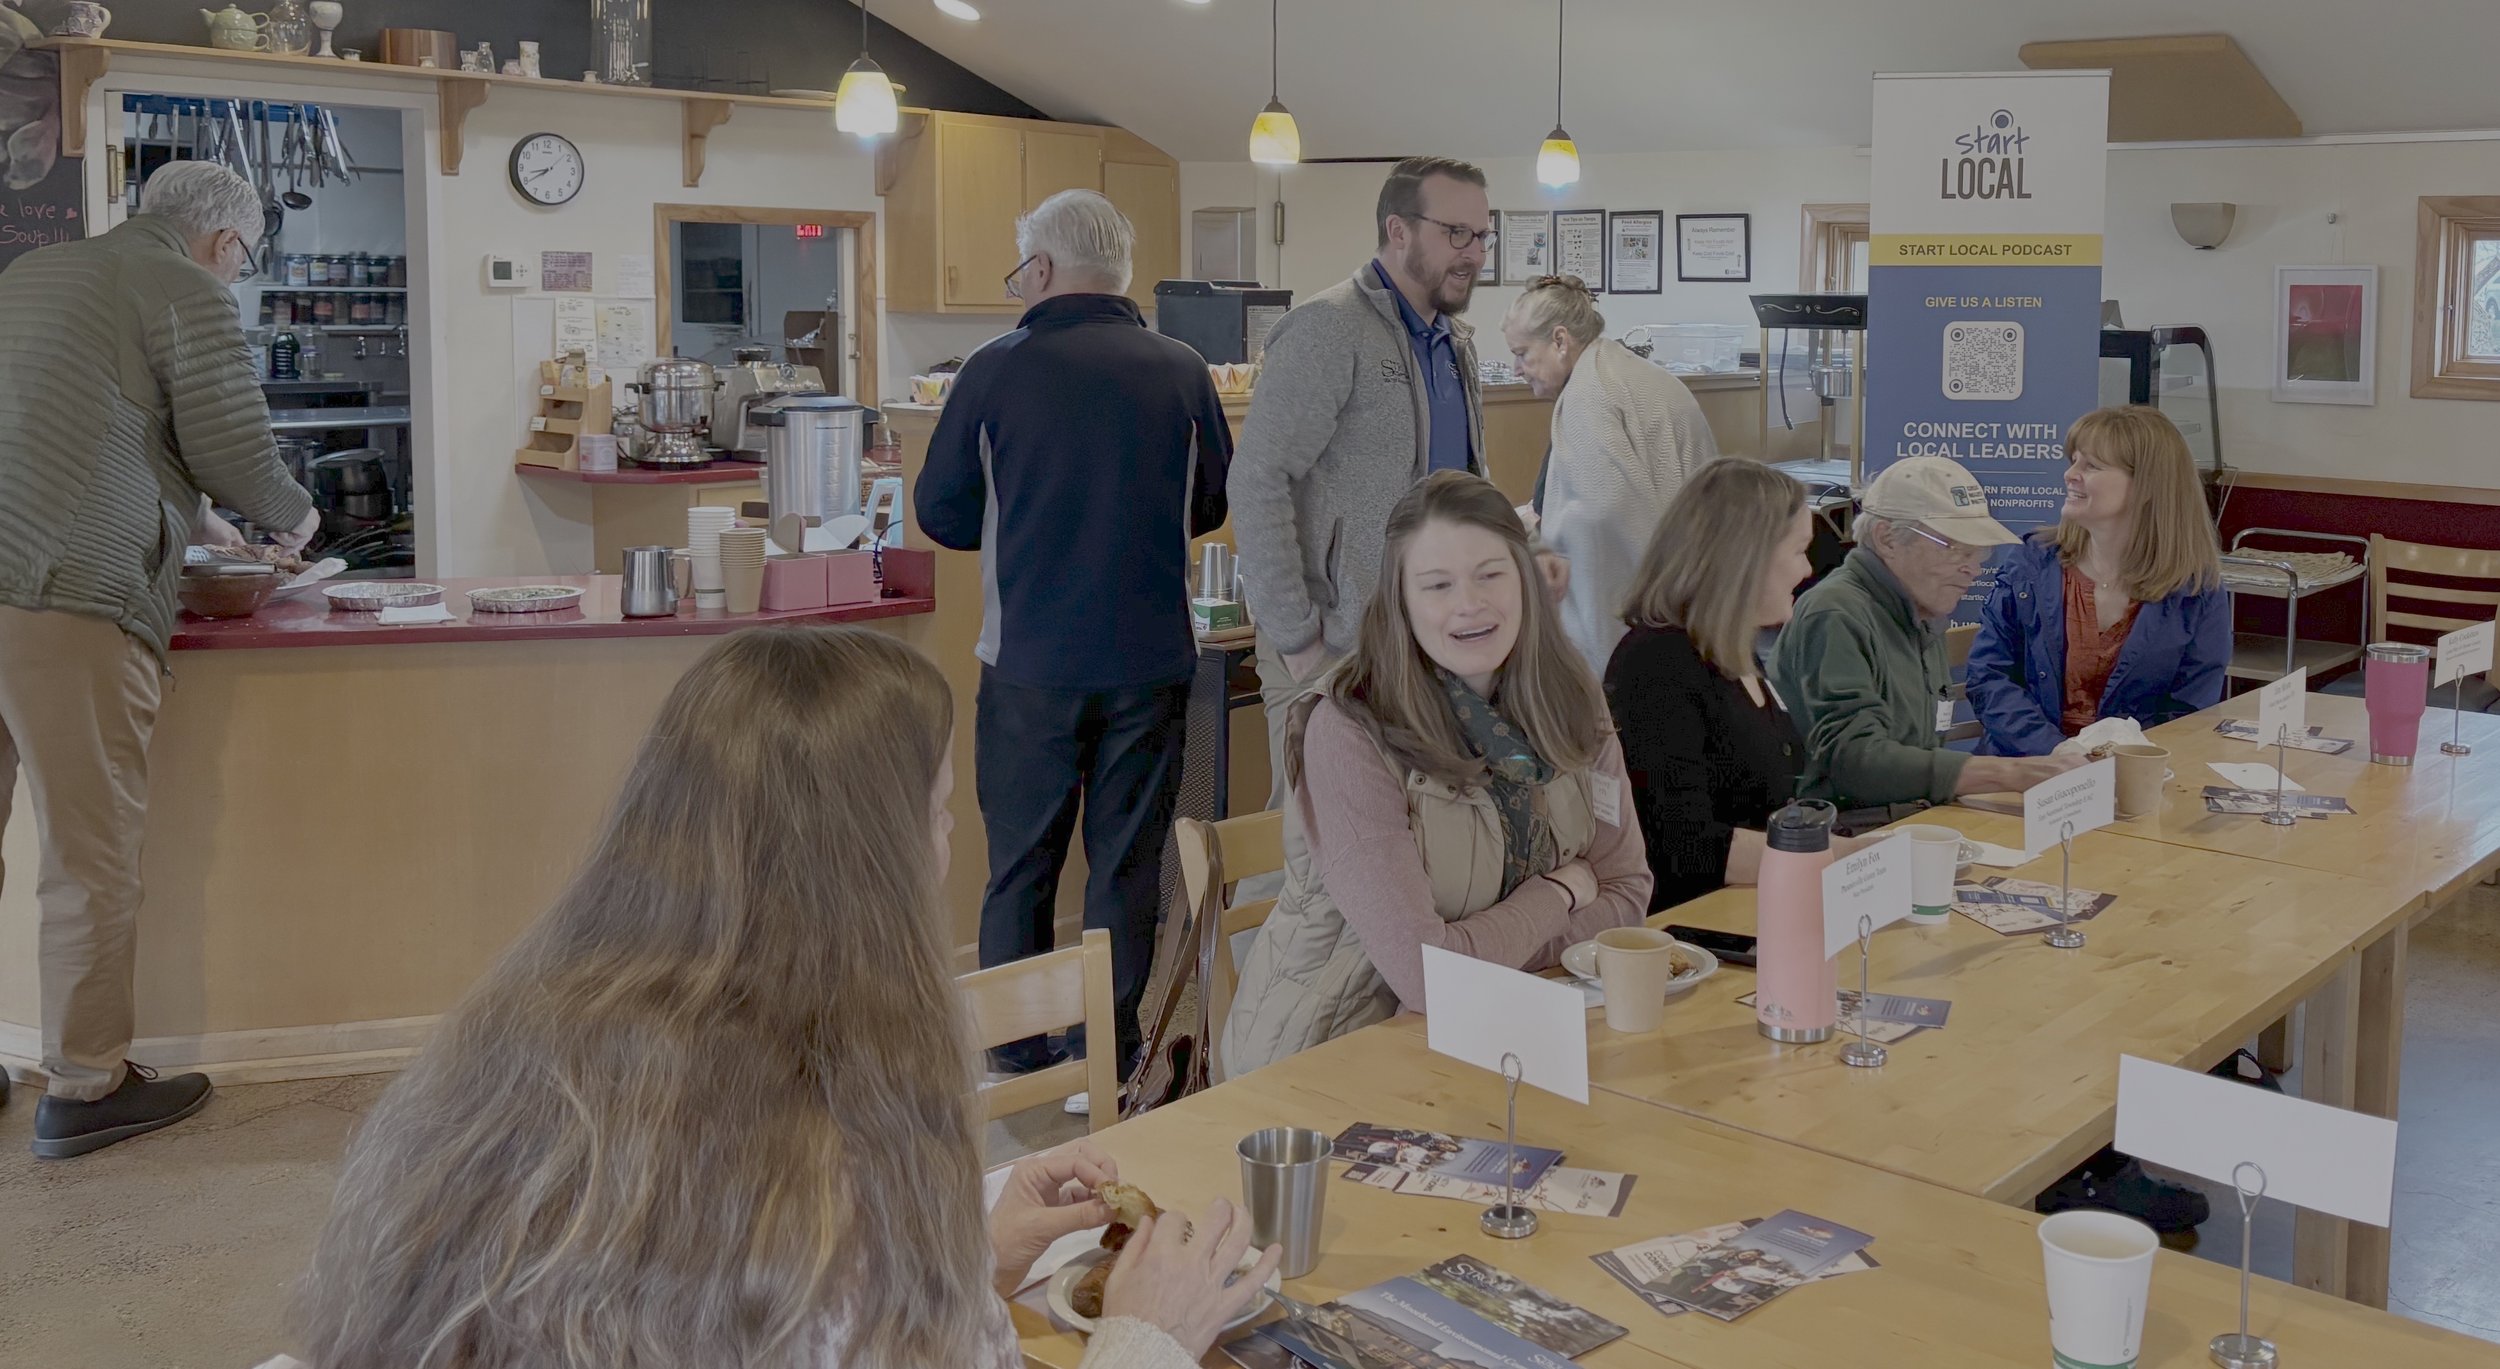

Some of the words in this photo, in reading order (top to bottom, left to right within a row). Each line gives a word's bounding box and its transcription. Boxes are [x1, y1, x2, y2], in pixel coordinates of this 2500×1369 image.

[543, 140, 552, 149] 12
[1955, 125, 2030, 155] start
[531, 142, 539, 151] 11
[558, 144, 562, 152] 1
[522, 151, 531, 160] 10
[566, 154, 571, 163] 2
[519, 163, 524, 172] 9
[570, 167, 575, 176] 3
[523, 176, 529, 185] 8
[1941, 158, 2032, 200] LOCAL
[566, 180, 571, 188] 4
[533, 187, 538, 196] 7
[545, 191, 550, 199] 6
[558, 188, 563, 197] 5
[18, 198, 56, 219] love
[1899, 244, 1945, 256] START
[1949, 244, 1998, 256] LOCAL
[2002, 244, 2073, 256] PODCAST
[1925, 297, 1957, 308] GIVE
[1960, 297, 1979, 308] US
[1981, 297, 1992, 308] A
[1995, 297, 2042, 308] LISTEN
[1903, 422, 2001, 439] CONNECT
[2006, 423, 2058, 440] WITH
[1896, 441, 1964, 458] LOCAL
[1969, 443, 2064, 460] LEADERS
[2000, 486, 2029, 495] FROM
[2032, 486, 2066, 496] LOCAL
[1990, 499, 2055, 508] NONPROFITS
[1868, 851, 1881, 865] Fox
[1380, 1292, 1398, 1304] The
